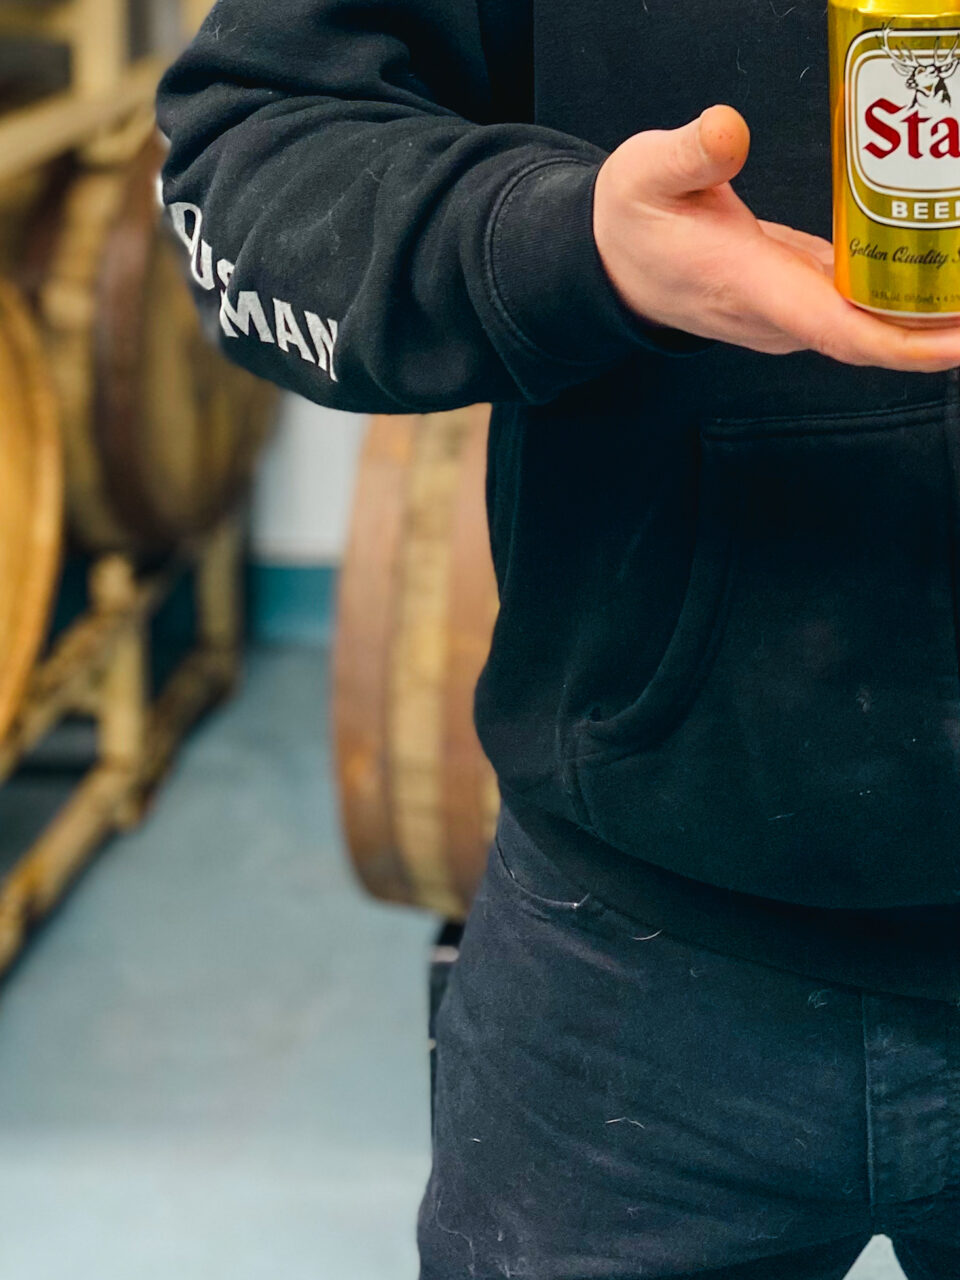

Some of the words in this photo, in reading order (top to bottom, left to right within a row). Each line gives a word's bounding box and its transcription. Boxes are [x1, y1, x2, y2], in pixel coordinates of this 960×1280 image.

[849, 237, 888, 261] Golden
[892, 246, 949, 269] Quality
[219, 287, 338, 382] MAN
